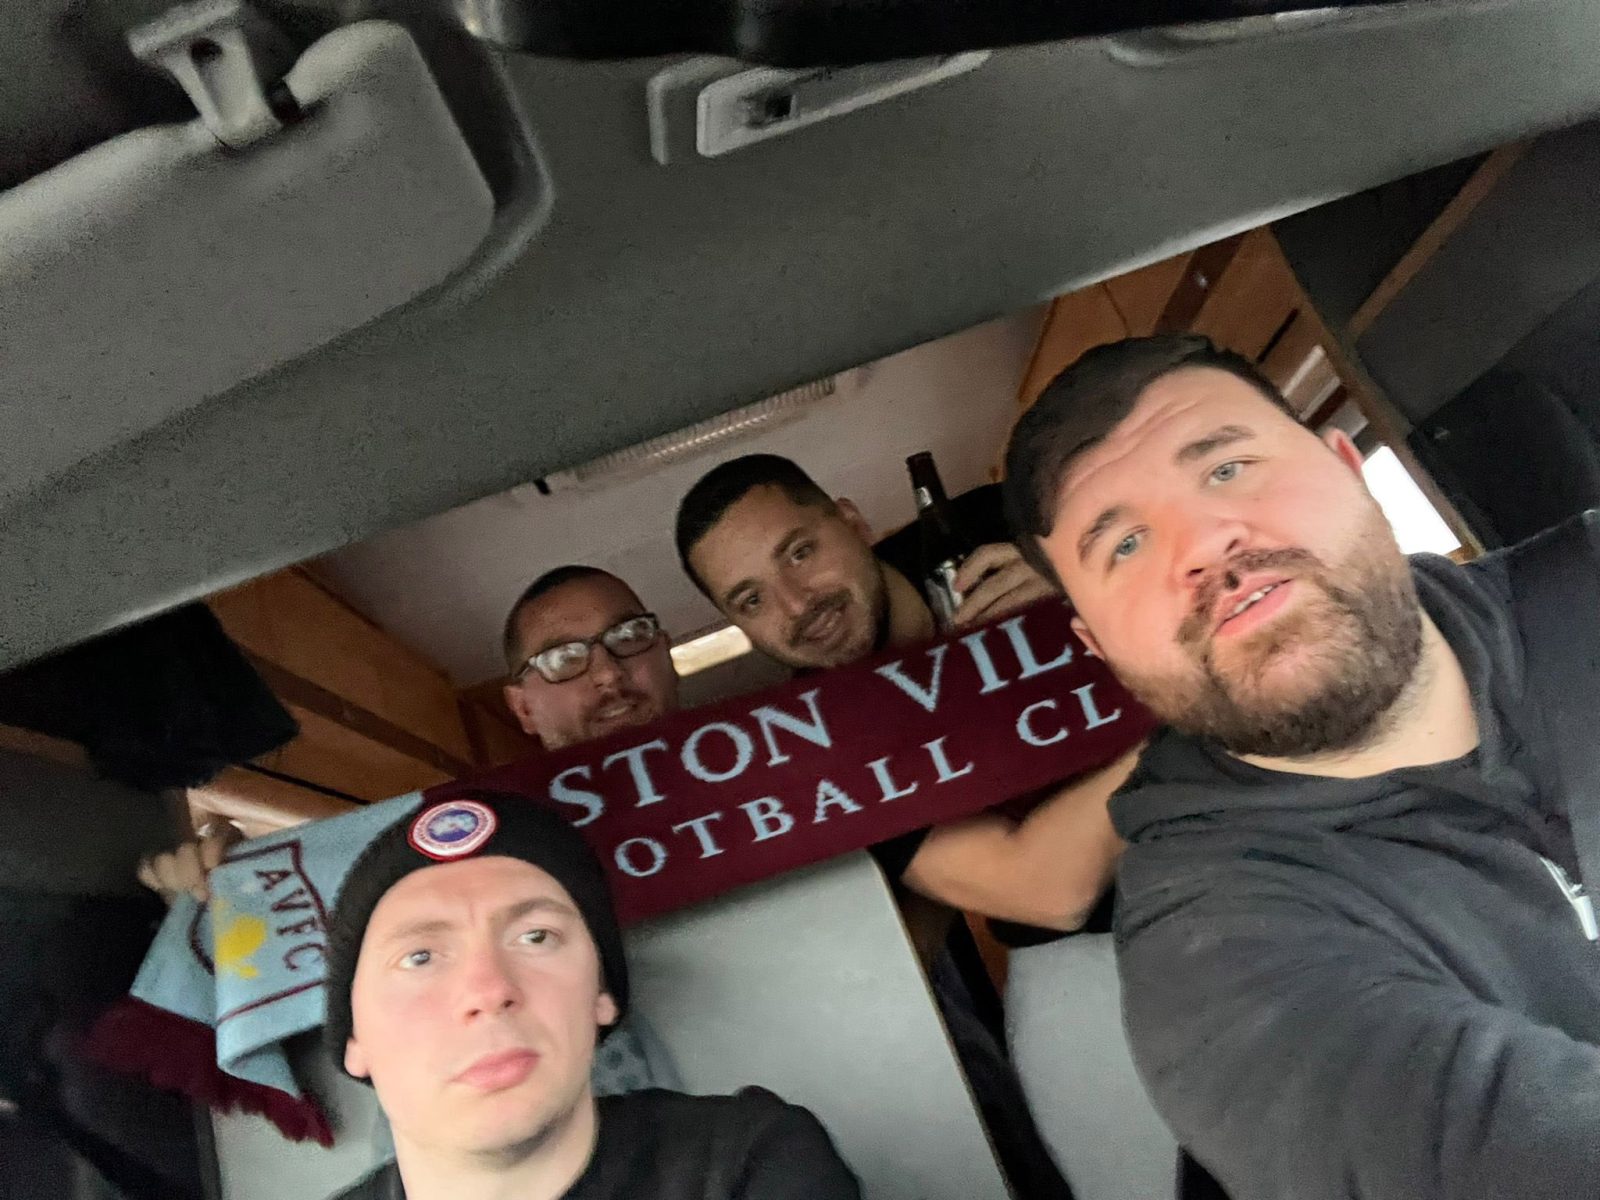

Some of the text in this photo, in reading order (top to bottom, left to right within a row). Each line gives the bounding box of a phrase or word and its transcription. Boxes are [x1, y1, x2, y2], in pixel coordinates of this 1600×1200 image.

[549, 614, 1094, 827] STON VIL
[615, 736, 974, 877] OTBALL
[1016, 682, 1122, 747] CL
[254, 869, 326, 970] AVFC
